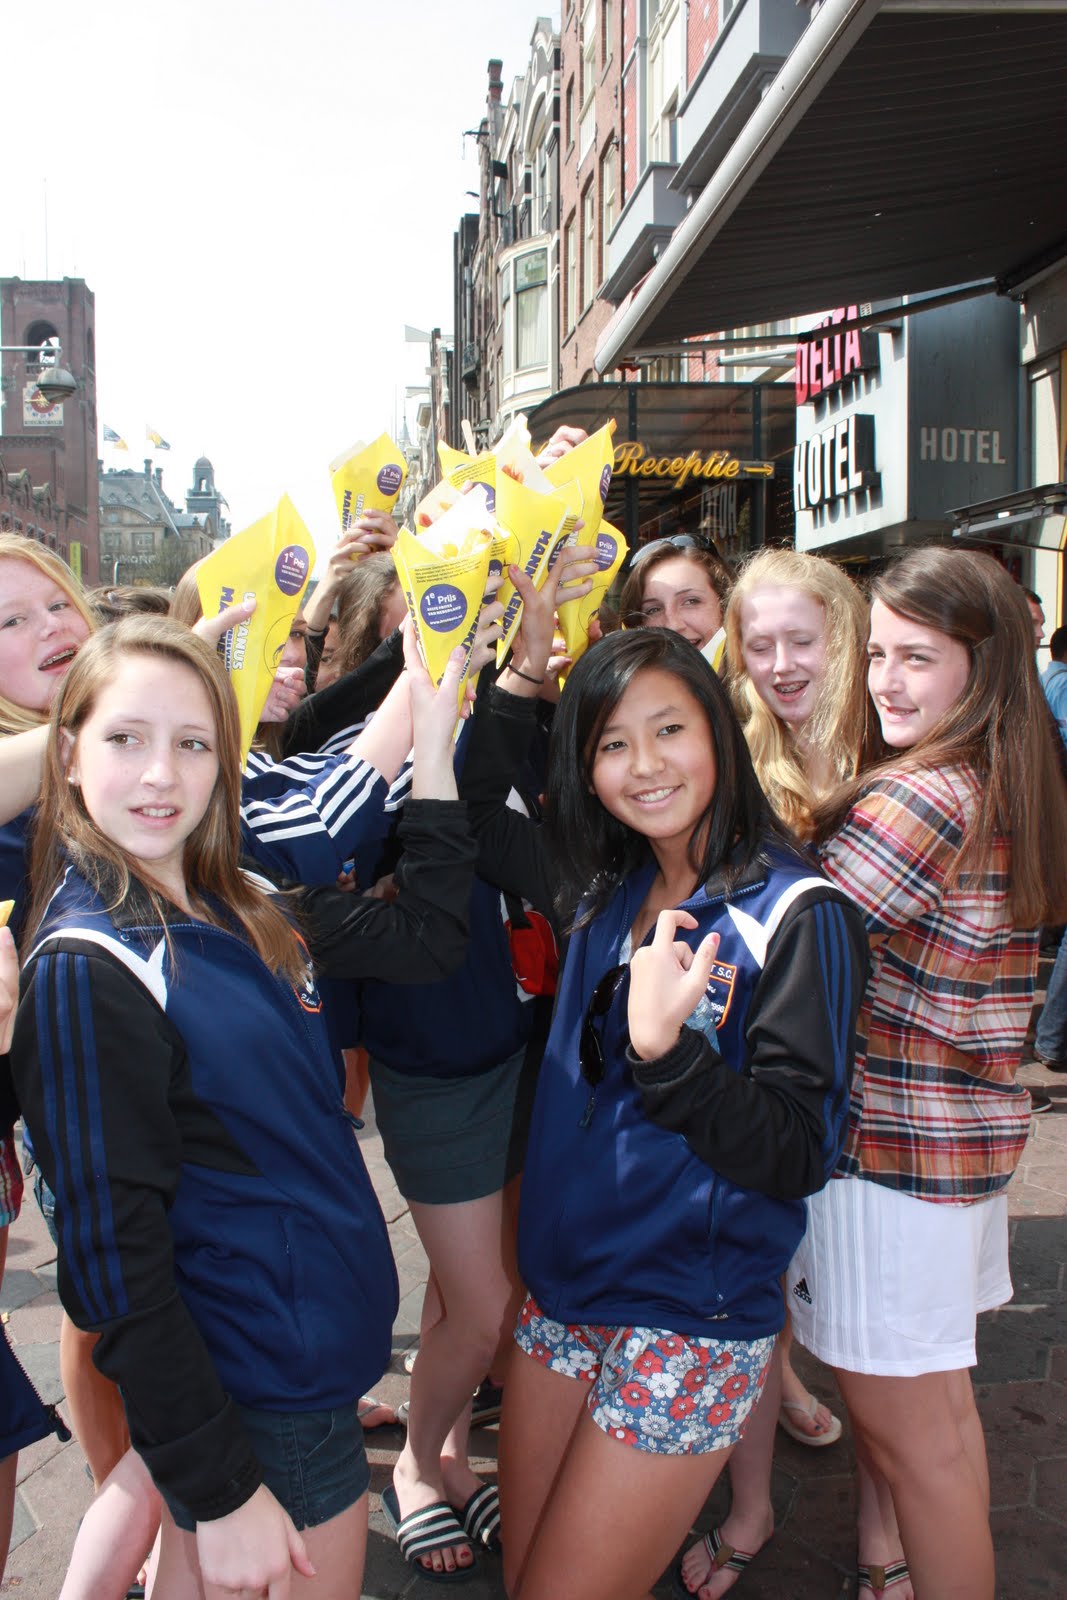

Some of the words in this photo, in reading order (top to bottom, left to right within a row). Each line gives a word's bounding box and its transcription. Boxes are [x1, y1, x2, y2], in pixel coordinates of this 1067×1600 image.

[795, 305, 861, 406] DELTA
[611, 441, 740, 489] Receptie
[793, 414, 863, 512] HOTEL
[920, 427, 1006, 465] HOTEL
[293, 557, 305, 569] Prijs
[599, 541, 613, 550] Prijs
[425, 592, 435, 606] 1e
[437, 593, 457, 605] Prijs
